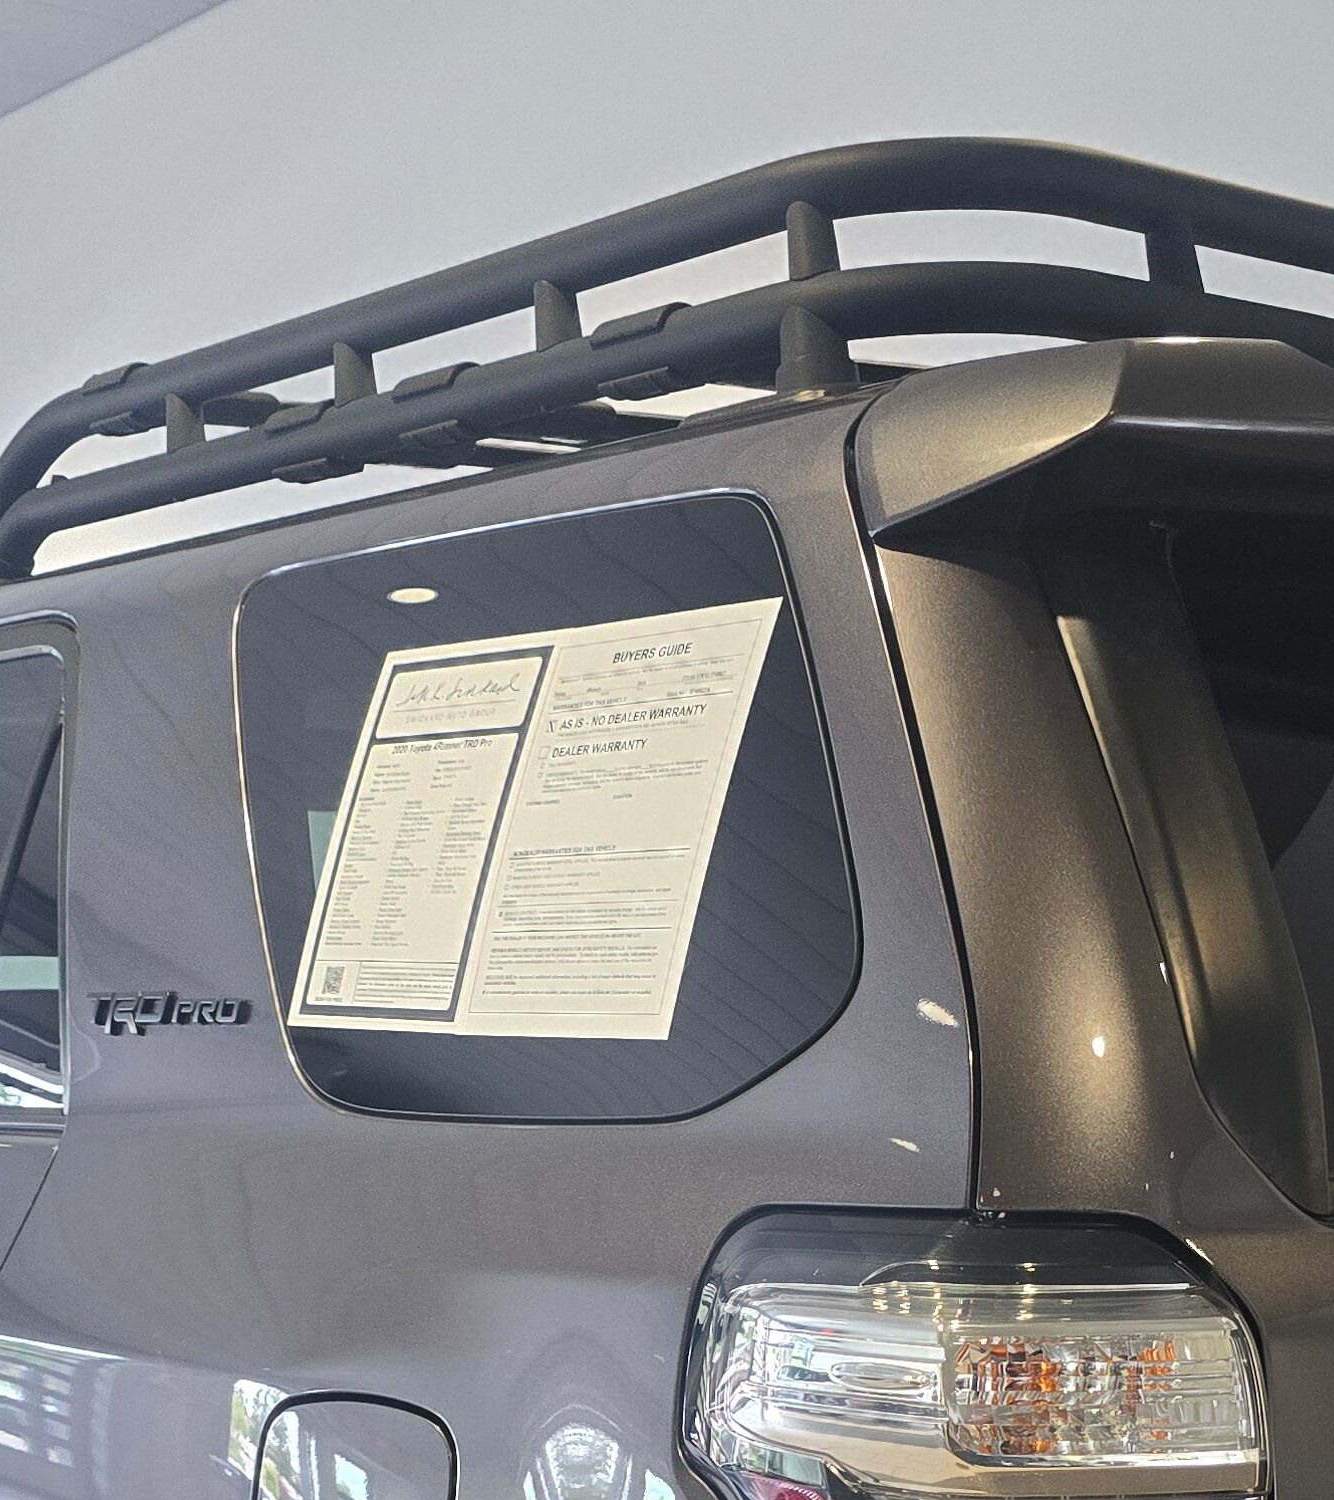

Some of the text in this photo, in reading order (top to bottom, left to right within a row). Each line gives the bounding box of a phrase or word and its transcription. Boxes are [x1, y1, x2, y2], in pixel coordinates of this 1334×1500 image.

[612, 642, 693, 664] BUYERS GUIDE
[559, 718, 573, 731] AS
[574, 717, 584, 729] IS
[591, 714, 606, 727] NO
[607, 710, 647, 725] DEALER
[649, 704, 707, 721] WARRANTY
[409, 743, 432, 756] Toyota
[464, 739, 478, 749] TRD
[480, 738, 493, 748] Pro
[552, 738, 648, 759] DEALER WARRANTY
[87, 991, 251, 1036] TRD PRO
